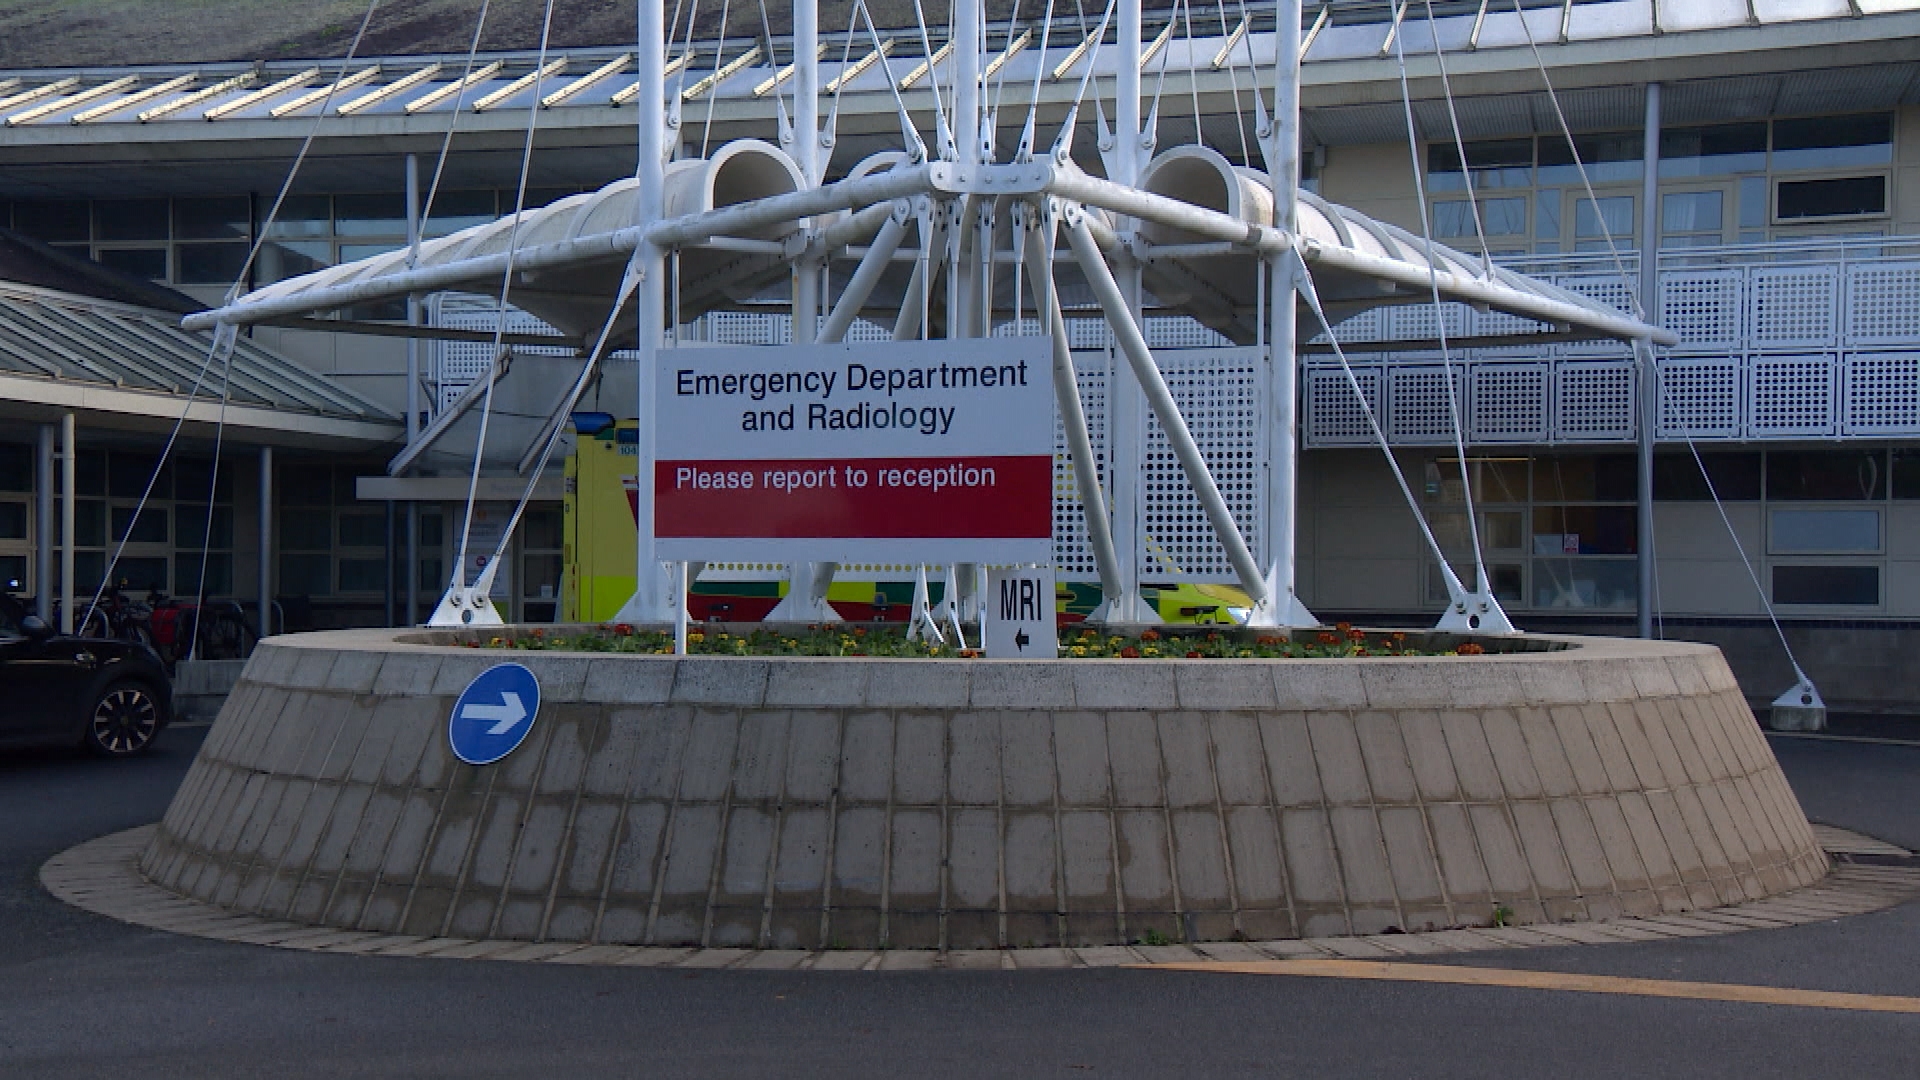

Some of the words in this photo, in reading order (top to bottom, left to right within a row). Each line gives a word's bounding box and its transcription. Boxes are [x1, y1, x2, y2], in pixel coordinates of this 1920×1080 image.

[676, 369, 837, 401] Emergency
[847, 359, 1028, 397] Department
[741, 403, 795, 432] and
[807, 401, 956, 435] Radiology
[675, 466, 754, 489] Please
[763, 465, 837, 495] report
[845, 465, 869, 487] to
[878, 463, 996, 493] reception
[1000, 578, 1042, 621] MRI
